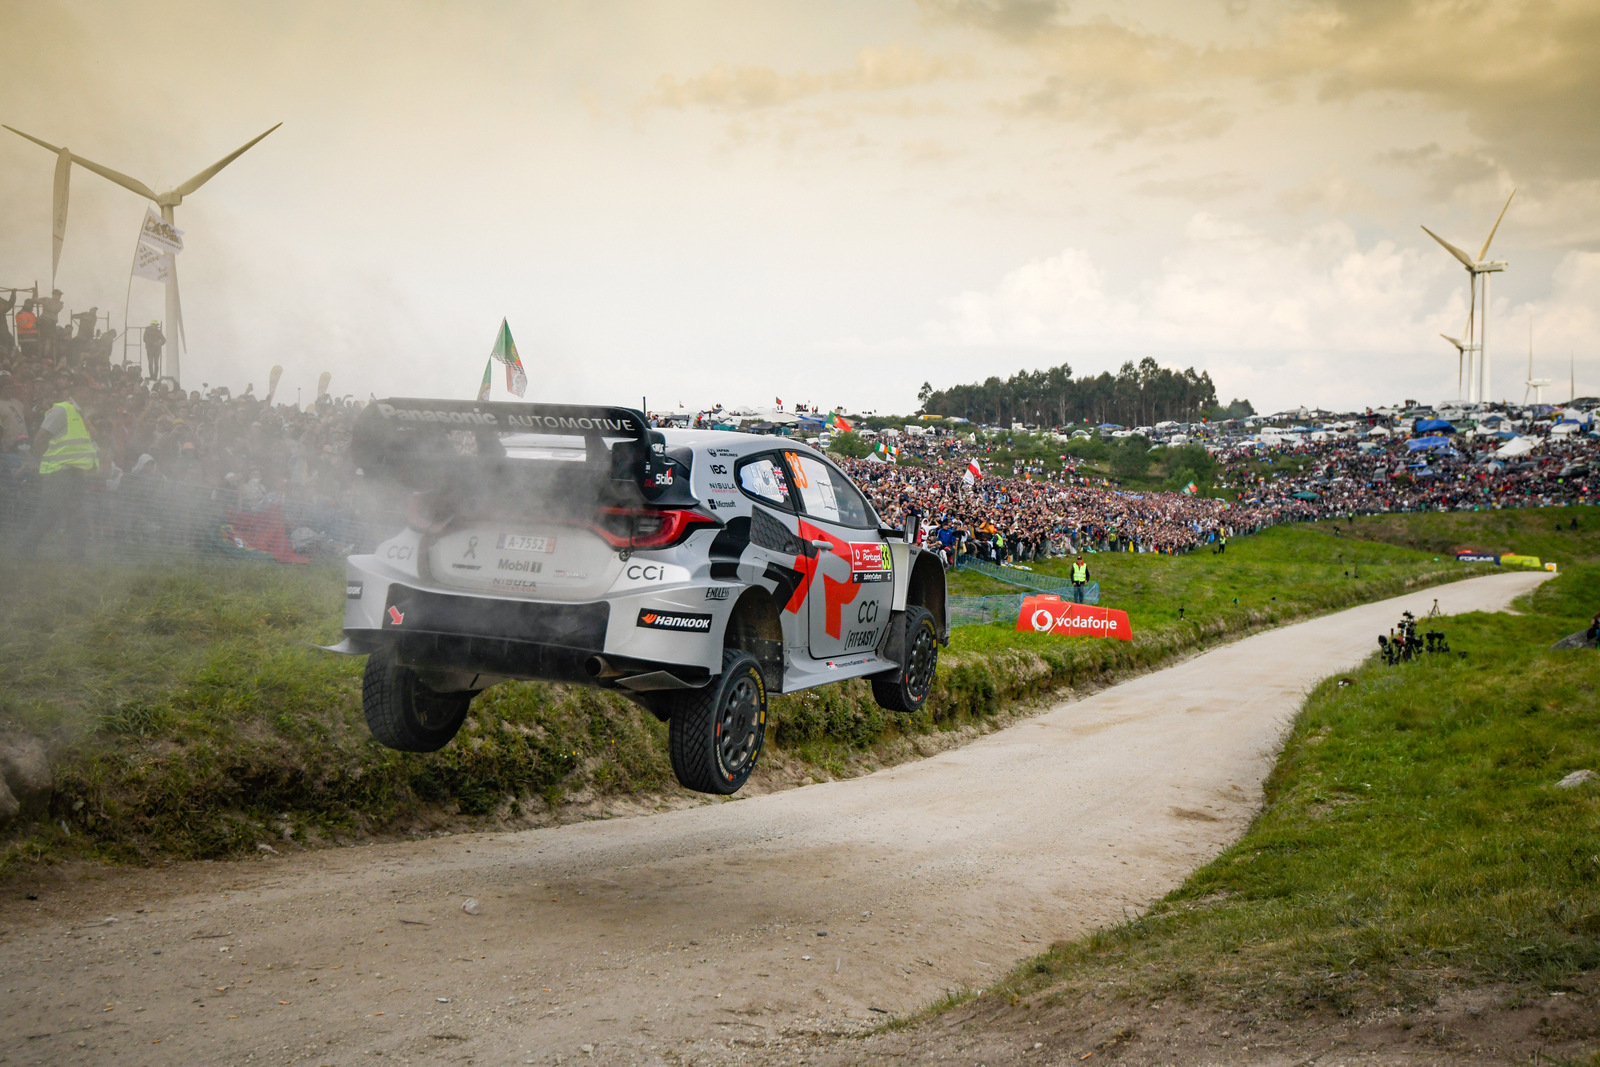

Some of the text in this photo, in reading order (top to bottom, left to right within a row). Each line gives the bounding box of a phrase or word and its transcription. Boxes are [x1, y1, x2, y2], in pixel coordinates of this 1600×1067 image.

[377, 403, 636, 432] Panasonic AUTOMOTIVE
[655, 468, 674, 485] Stilo
[784, 451, 808, 489] 33
[709, 482, 737, 490] NISULA
[716, 500, 737, 508] Microsoft
[507, 535, 545, 550] A-7552
[862, 552, 881, 563] Portugal
[880, 544, 891, 570] 33
[497, 558, 530, 572] Mobil
[627, 565, 665, 581] CCi
[492, 577, 537, 588] NISULA
[705, 586, 731, 599] ENDLESS
[857, 600, 879, 624] CCi
[1056, 615, 1117, 630] vodafone
